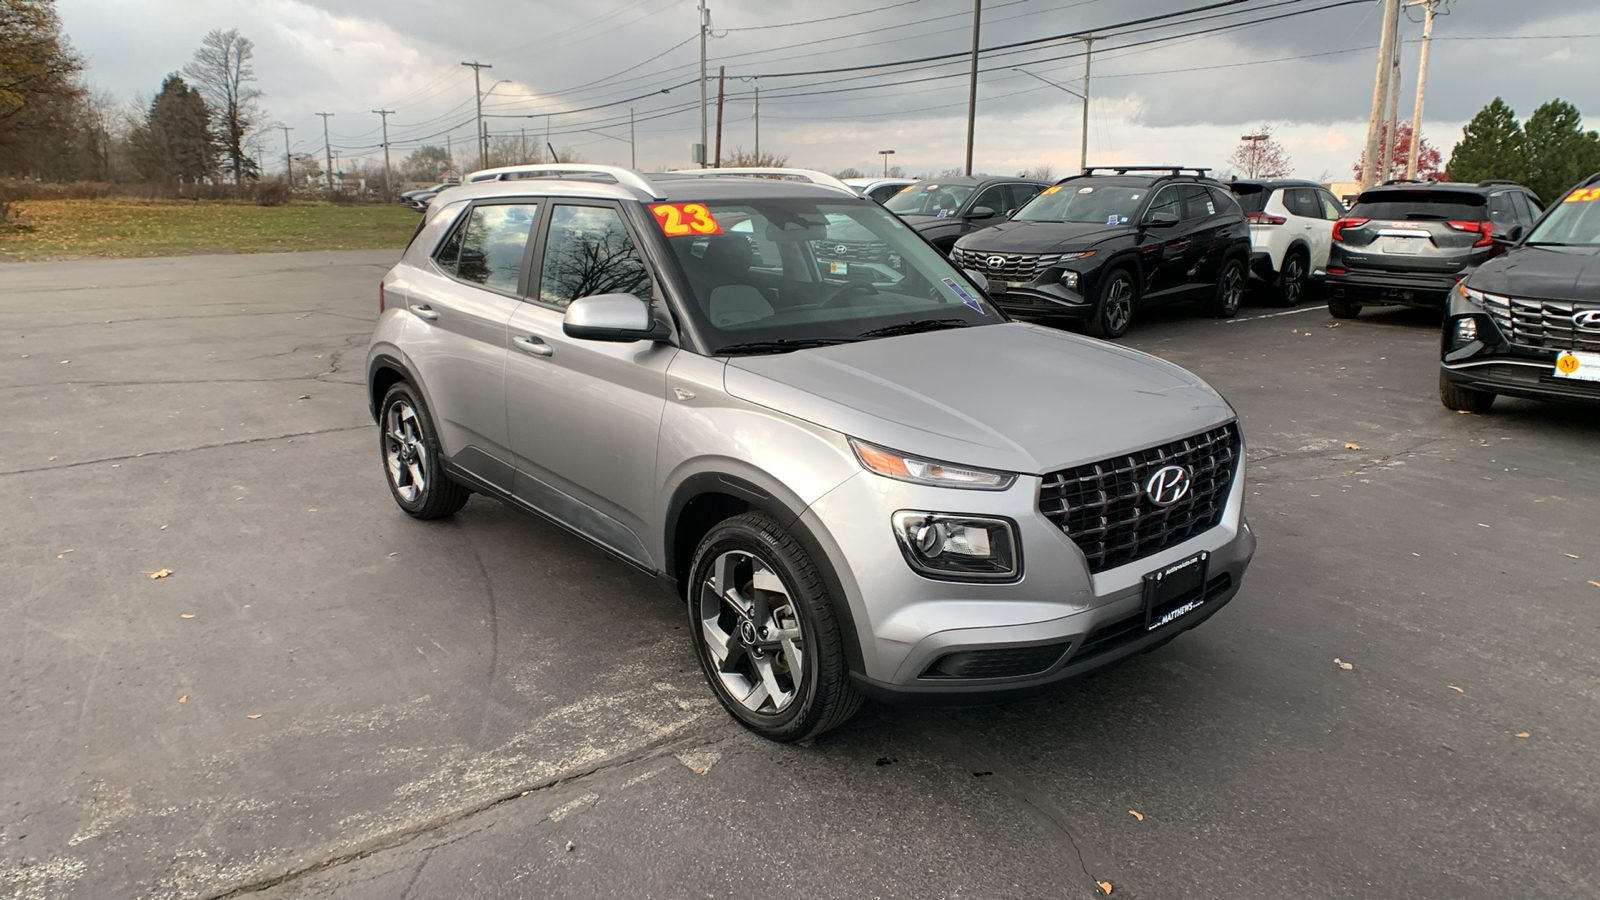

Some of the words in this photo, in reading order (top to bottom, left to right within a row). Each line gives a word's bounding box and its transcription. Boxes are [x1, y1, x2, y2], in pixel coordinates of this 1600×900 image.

[1564, 188, 1600, 202] 23
[653, 204, 718, 234] 23
[1161, 602, 1193, 625] MATTHEWS
